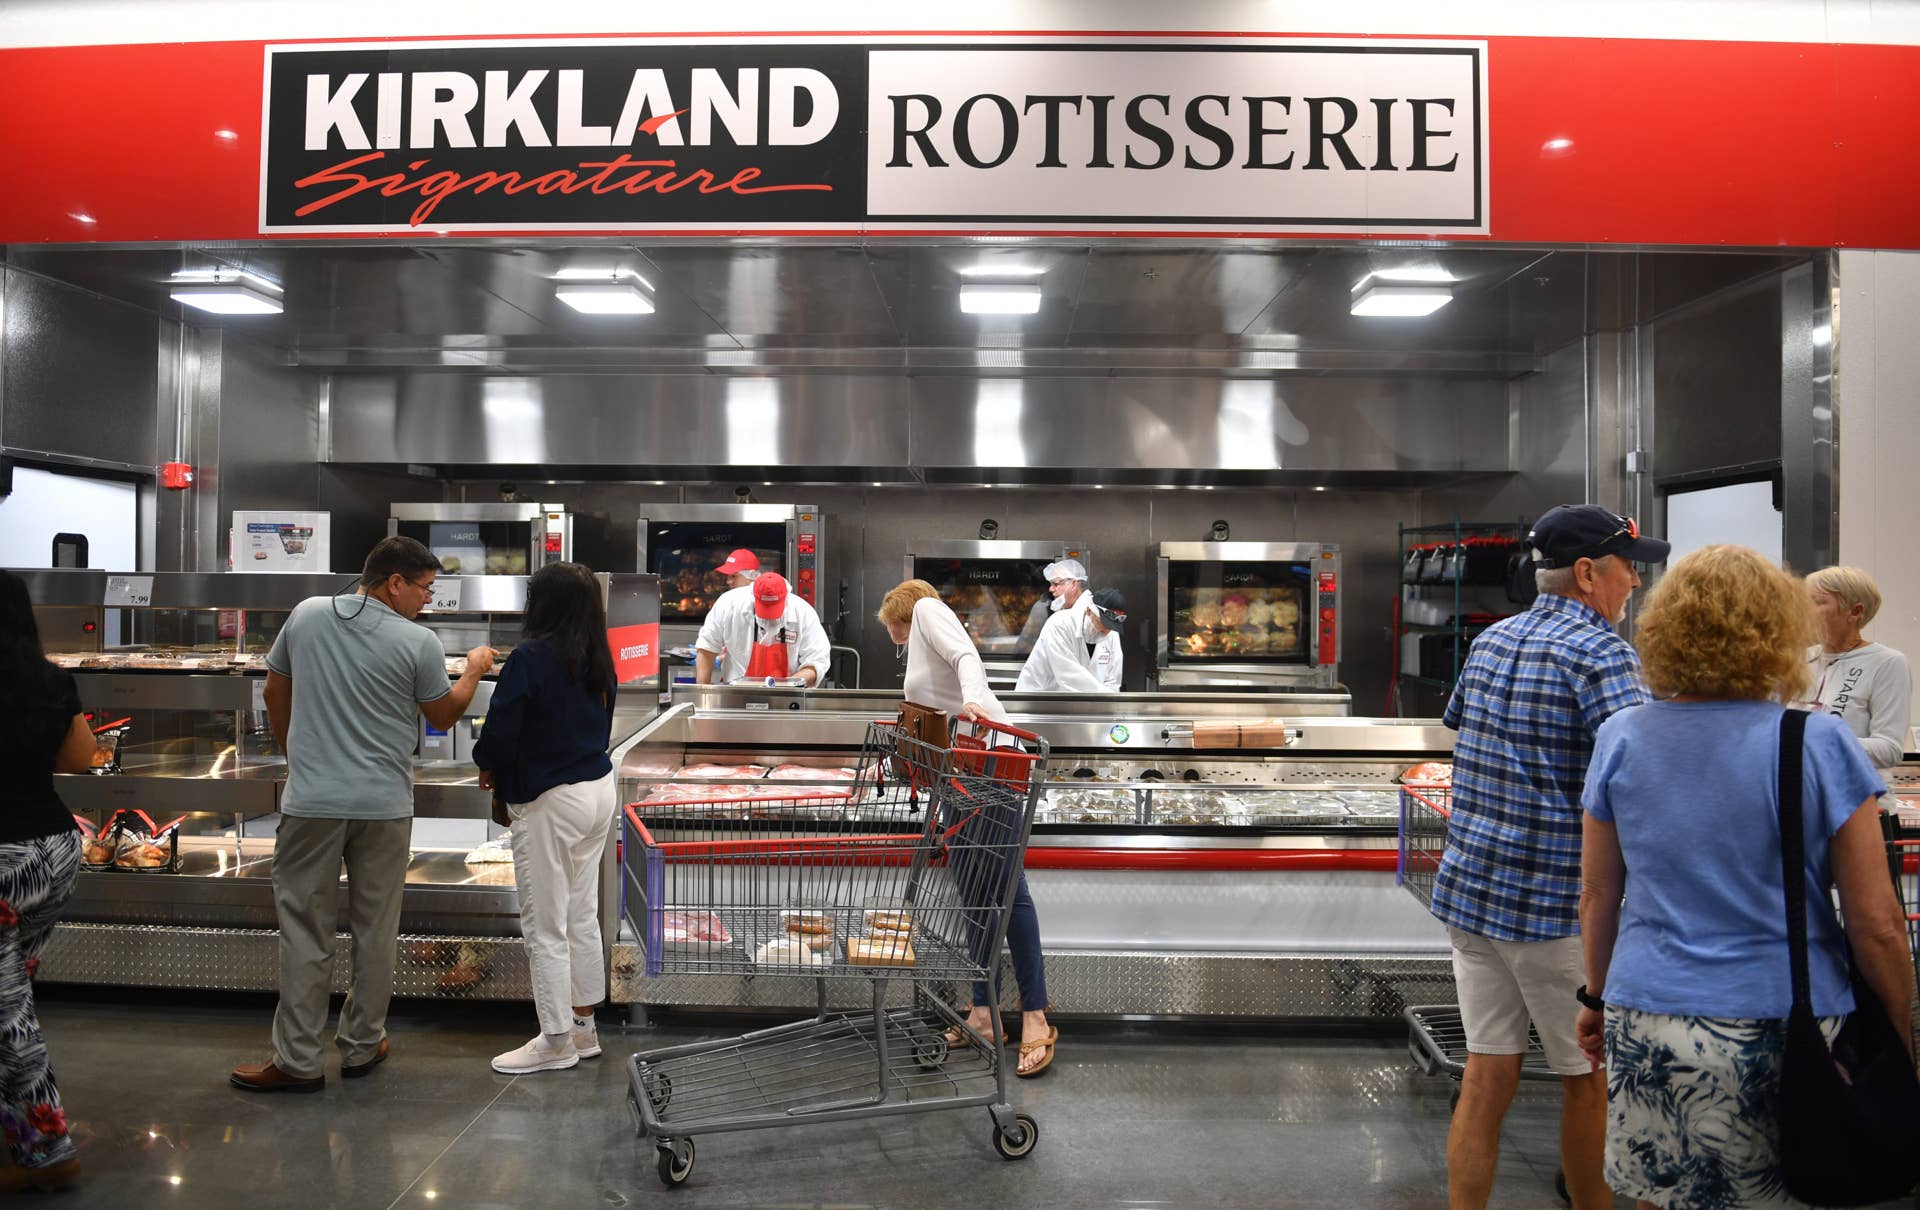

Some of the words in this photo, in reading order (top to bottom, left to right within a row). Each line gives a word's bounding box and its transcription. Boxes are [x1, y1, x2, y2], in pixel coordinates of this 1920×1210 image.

[304, 67, 840, 151] KIRKLAND
[885, 93, 1459, 172] ROTISSERIE
[294, 152, 833, 228] Signature
[450, 532, 481, 541] HARDT
[130, 595, 149, 604] 7.99
[437, 599, 457, 608] 6.49
[620, 643, 649, 661] ROTISSERIE
